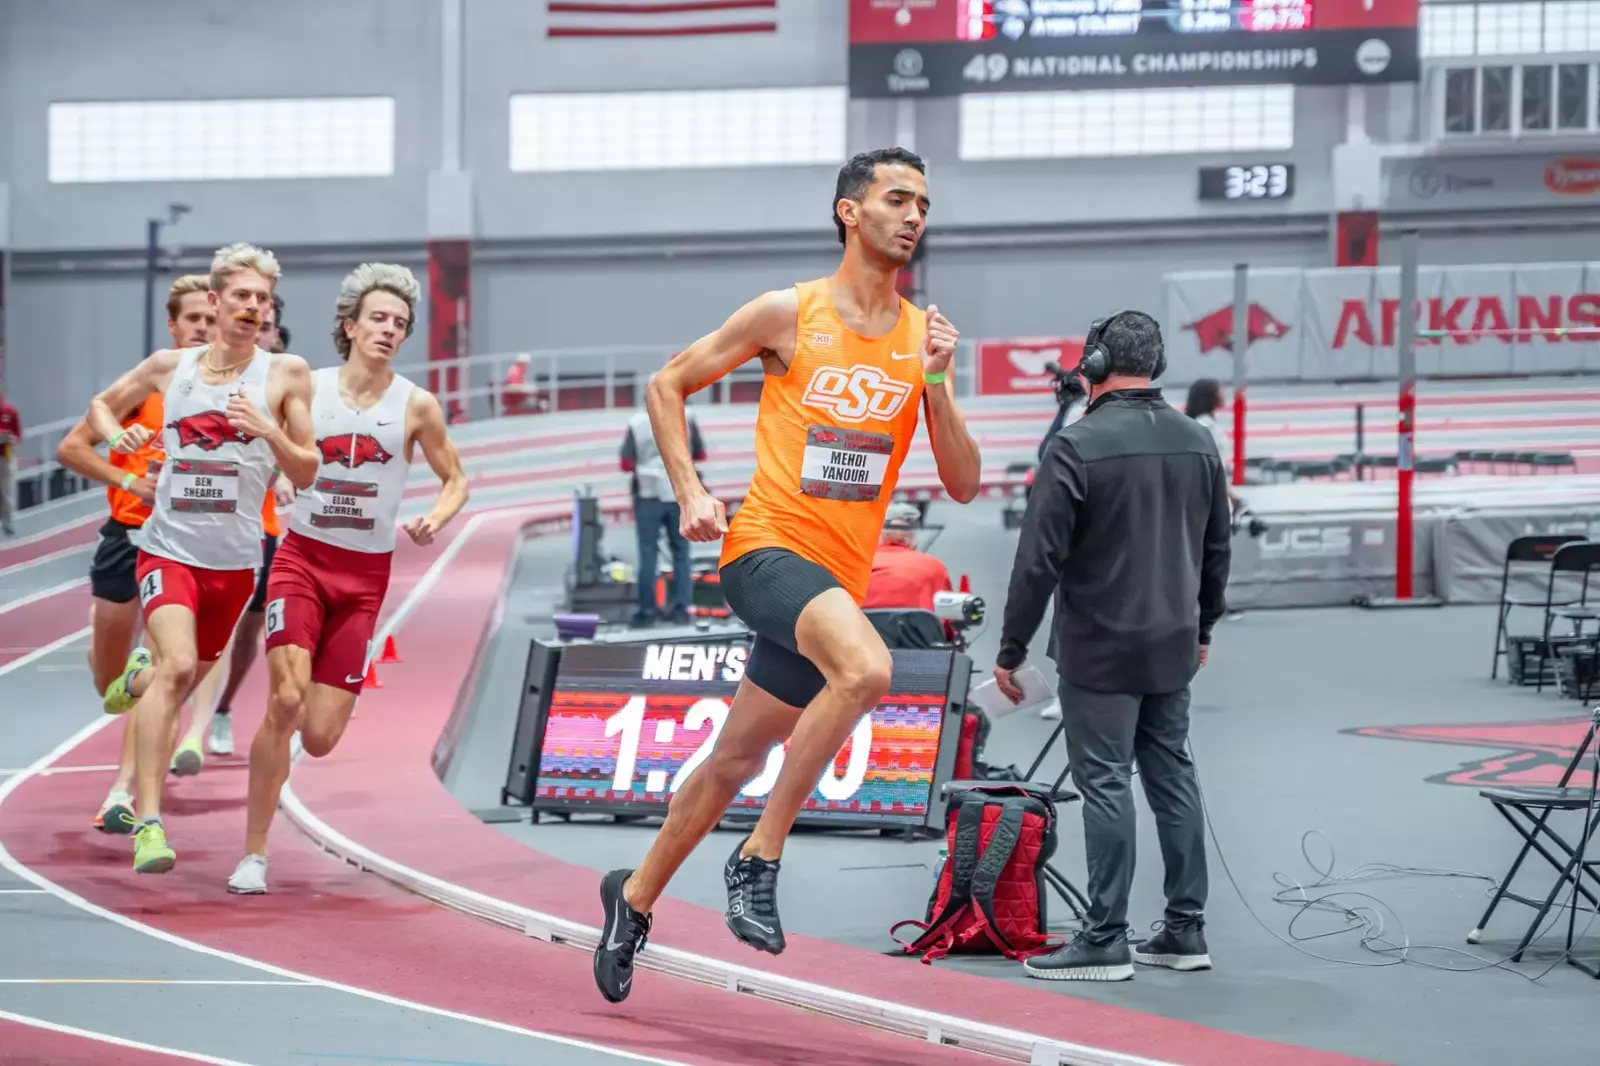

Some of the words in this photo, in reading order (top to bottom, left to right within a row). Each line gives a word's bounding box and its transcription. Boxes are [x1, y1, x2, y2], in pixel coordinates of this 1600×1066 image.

[962, 53, 1009, 83] 49
[1012, 54, 1128, 77] NATIONAL
[1132, 47, 1318, 74] CHAMPIONSHIPS
[1225, 165, 1287, 198] 3:23
[801, 364, 913, 424] OSU
[830, 451, 867, 468] MEHDI
[194, 476, 213, 487] BEN
[822, 466, 870, 483] YANOURI
[332, 496, 357, 506] ELIAS
[142, 573, 158, 599] 4
[267, 602, 277, 633] 6
[642, 644, 748, 682] MEN'S
